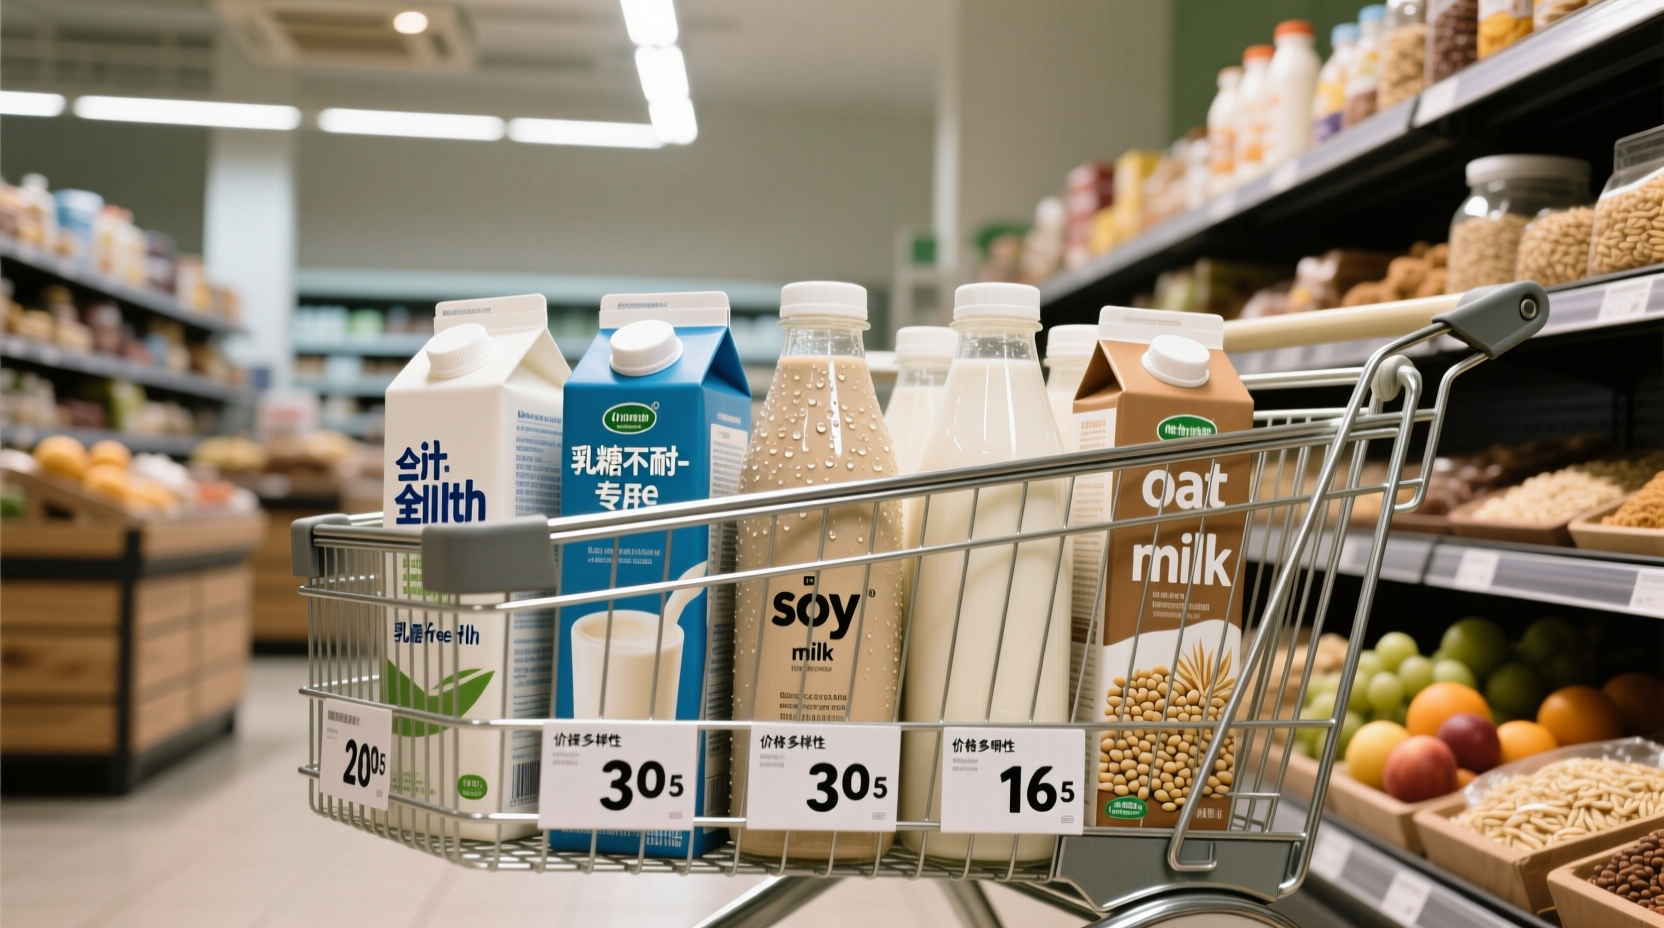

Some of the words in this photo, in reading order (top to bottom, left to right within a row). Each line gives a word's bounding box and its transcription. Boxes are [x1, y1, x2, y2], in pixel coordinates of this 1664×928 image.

[1142, 463, 1228, 510] oat
[1132, 532, 1232, 587] milk
[771, 591, 861, 640] soy
[792, 642, 834, 662] milk
